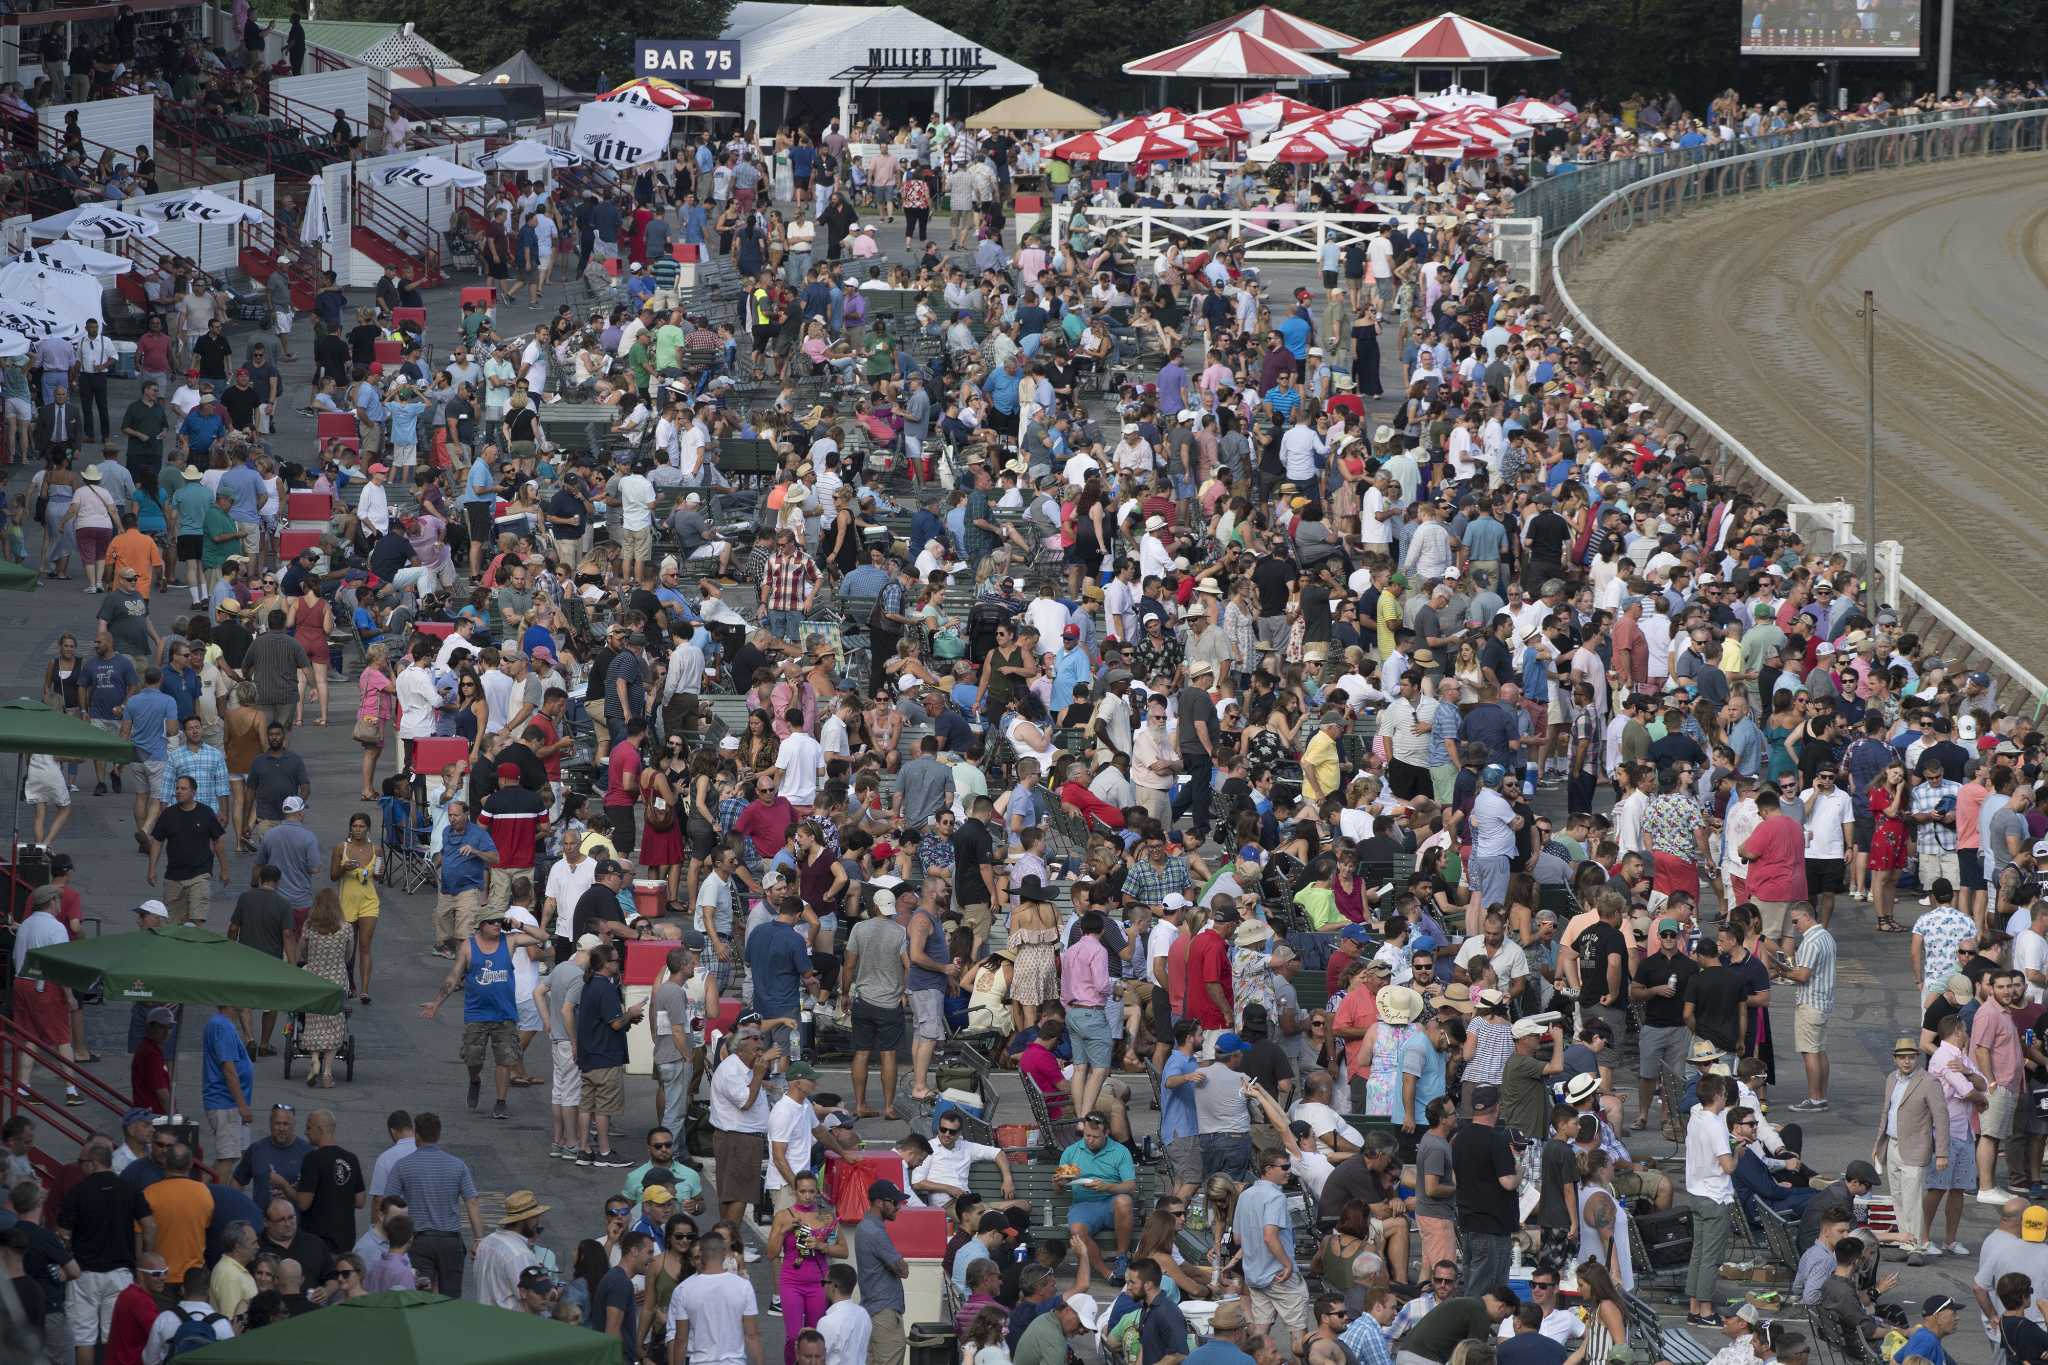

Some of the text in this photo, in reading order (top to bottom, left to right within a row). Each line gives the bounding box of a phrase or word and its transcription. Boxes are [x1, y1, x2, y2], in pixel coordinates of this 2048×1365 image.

[645, 49, 732, 71] BAR 75
[868, 48, 982, 67] MILLER TIME
